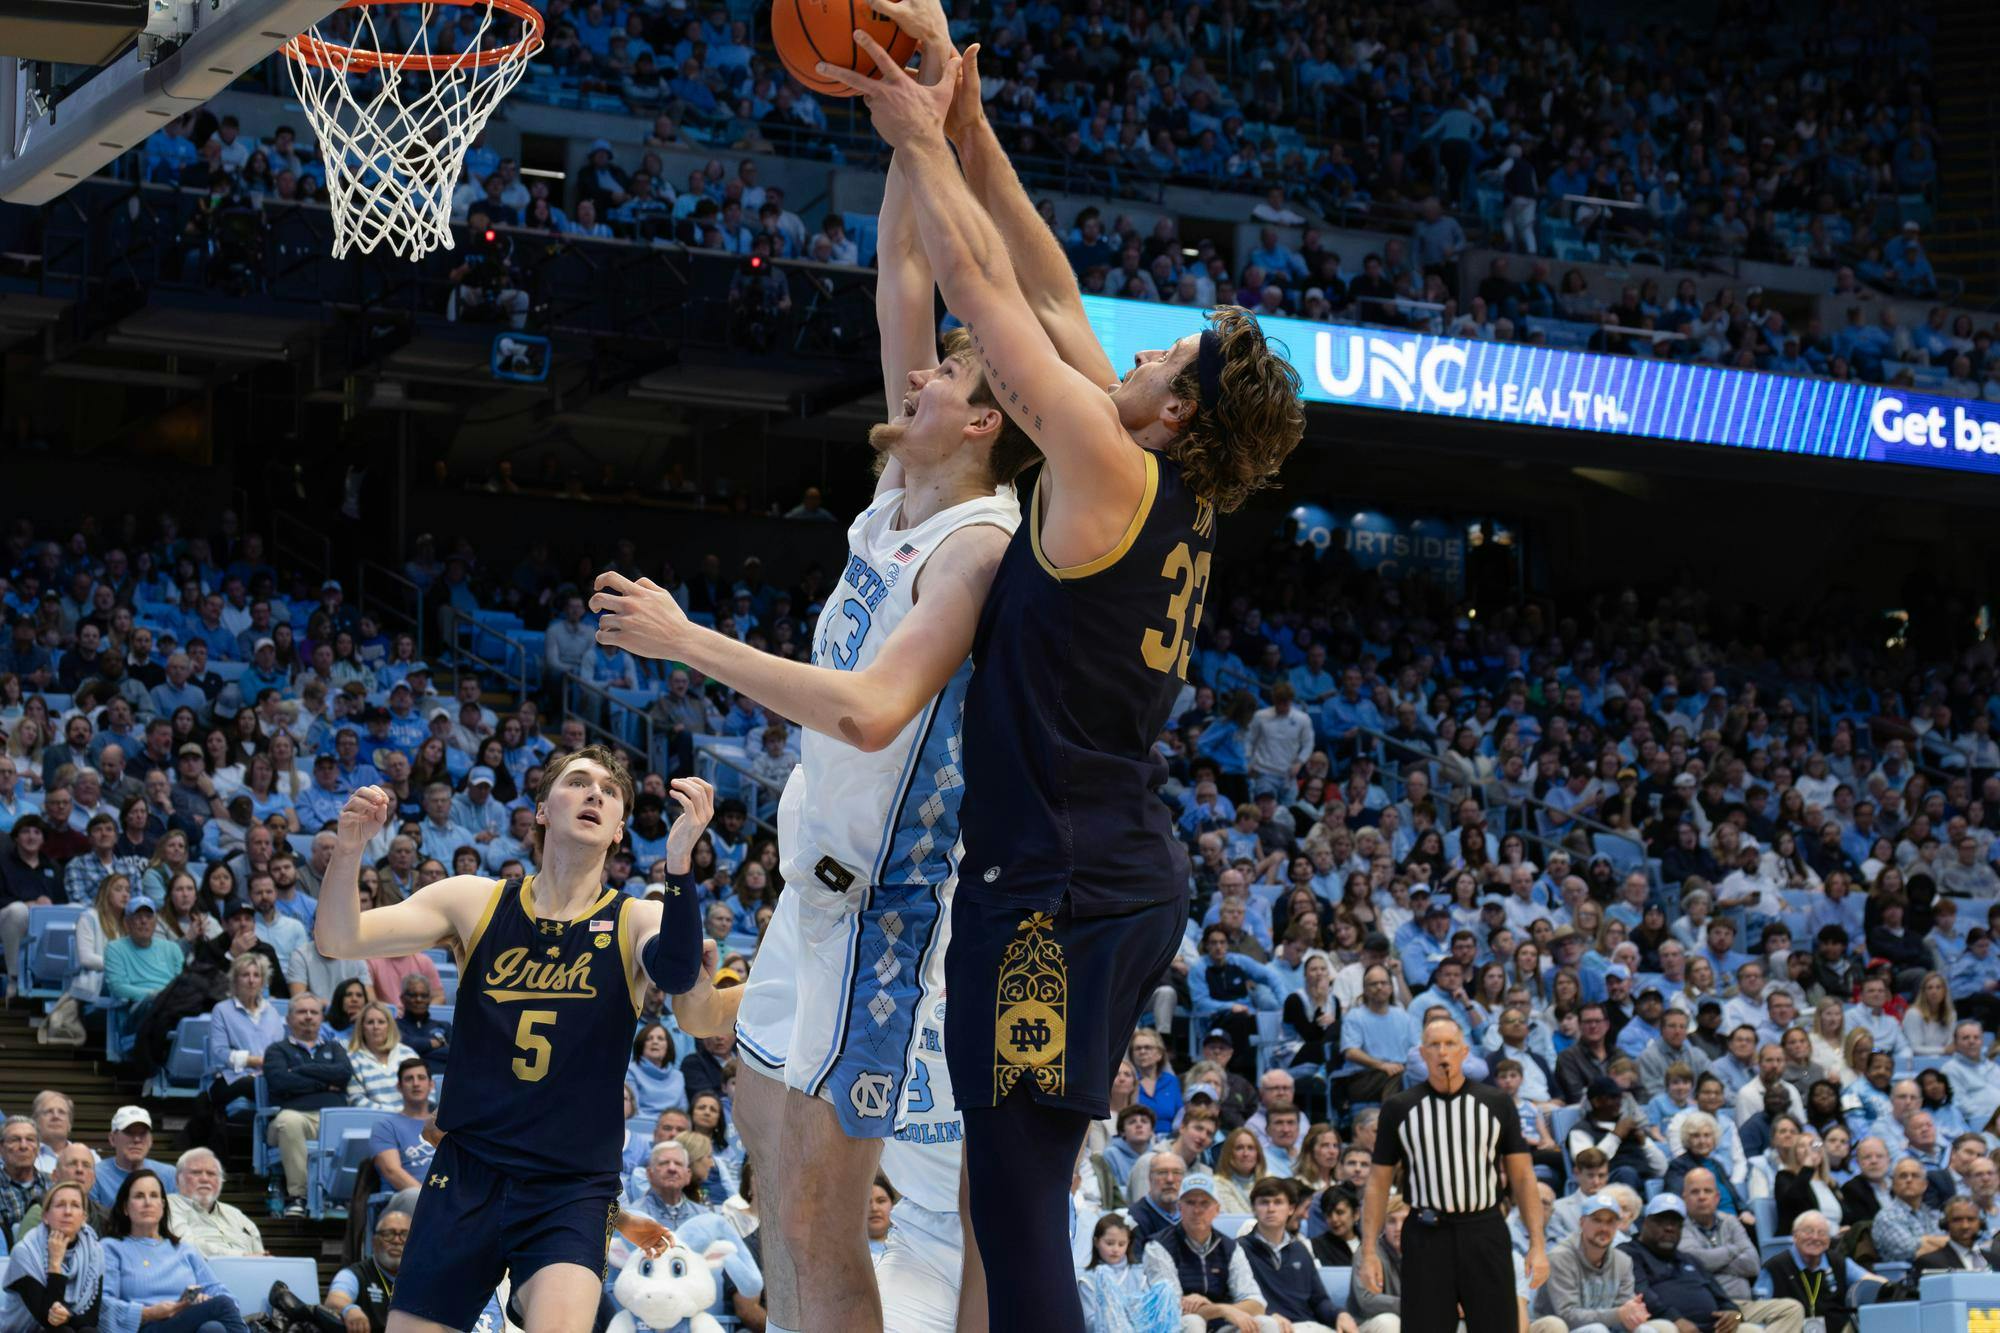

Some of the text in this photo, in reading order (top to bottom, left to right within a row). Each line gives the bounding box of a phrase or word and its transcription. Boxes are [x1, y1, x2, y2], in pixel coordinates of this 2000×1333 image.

[1315, 331, 1467, 408] UNC
[1872, 397, 1947, 448] Get
[484, 947, 597, 999] Irish
[512, 1009, 558, 1082] 5
